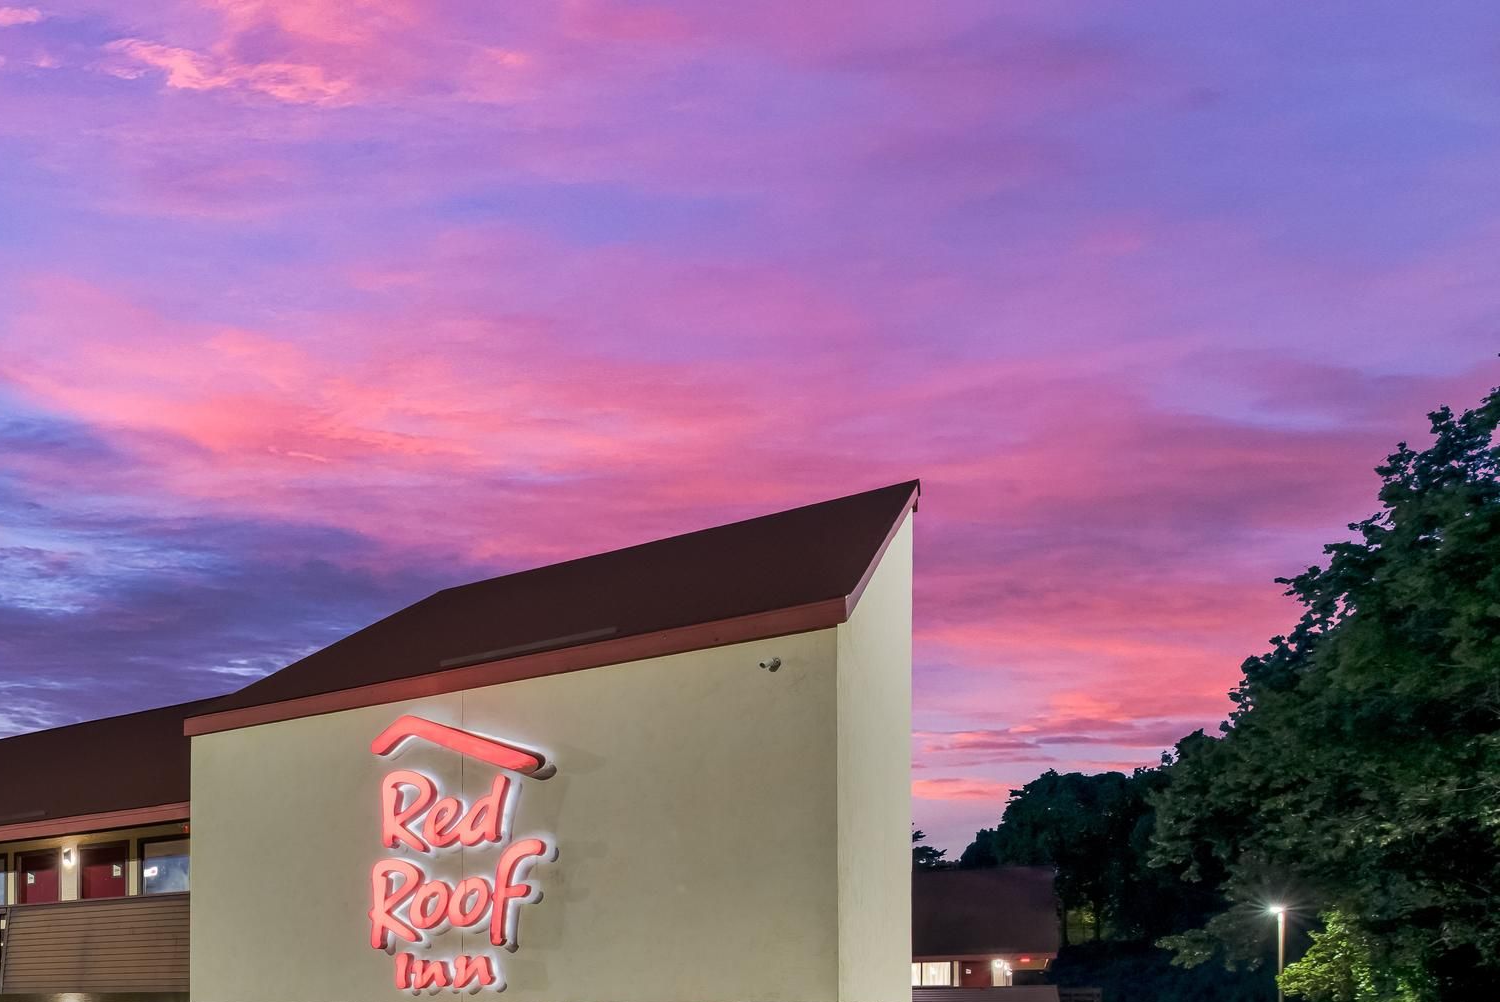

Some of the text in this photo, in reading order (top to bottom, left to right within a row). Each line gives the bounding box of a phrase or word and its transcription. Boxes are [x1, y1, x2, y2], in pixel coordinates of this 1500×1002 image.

[382, 770, 511, 853] Red
[369, 838, 546, 949] Roof
[395, 952, 497, 989] Inn
